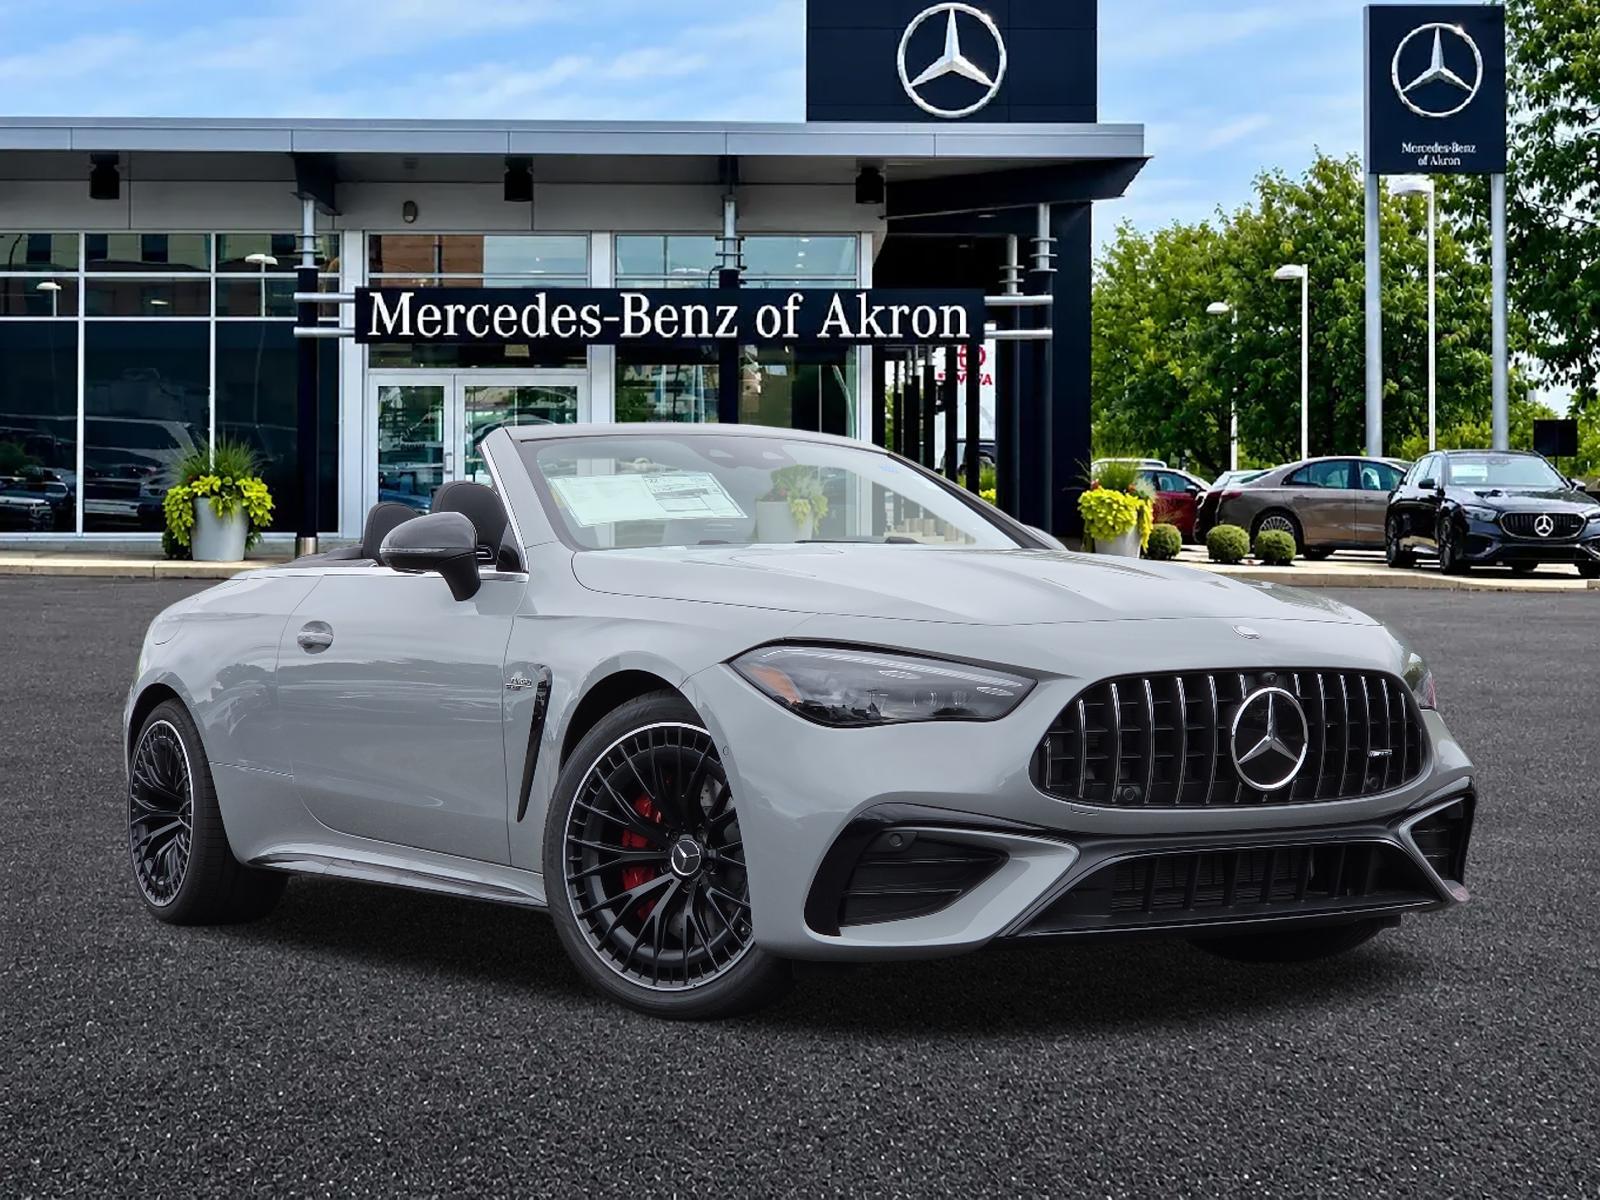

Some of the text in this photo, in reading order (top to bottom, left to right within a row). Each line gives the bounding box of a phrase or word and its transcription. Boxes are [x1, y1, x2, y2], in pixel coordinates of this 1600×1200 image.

[1400, 141, 1477, 154] Mercedes-Benz
[1417, 154, 1461, 166] of Akron
[365, 291, 971, 338] Mercedes-Benz of Akron
